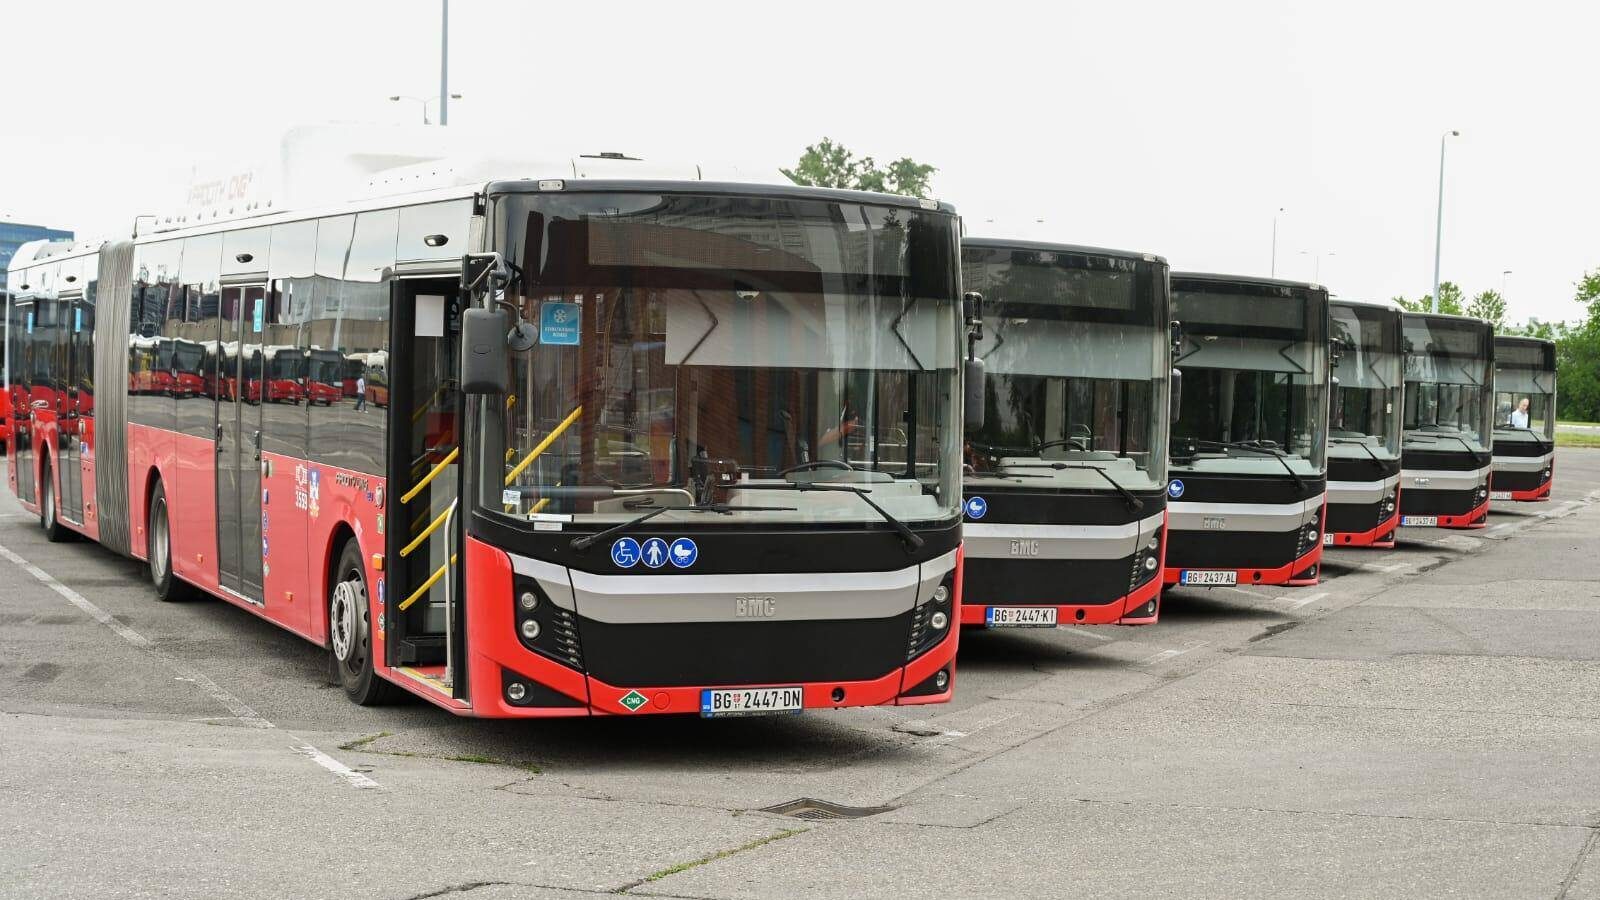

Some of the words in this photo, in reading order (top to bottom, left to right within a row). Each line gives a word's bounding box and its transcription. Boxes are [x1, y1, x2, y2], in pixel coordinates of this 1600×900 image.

[1010, 540, 1039, 556] BMC
[1187, 572, 1198, 583] BG
[736, 597, 776, 617] BMC
[994, 609, 1008, 622] BG
[626, 697, 641, 705] CNG
[713, 693, 731, 709] BG
